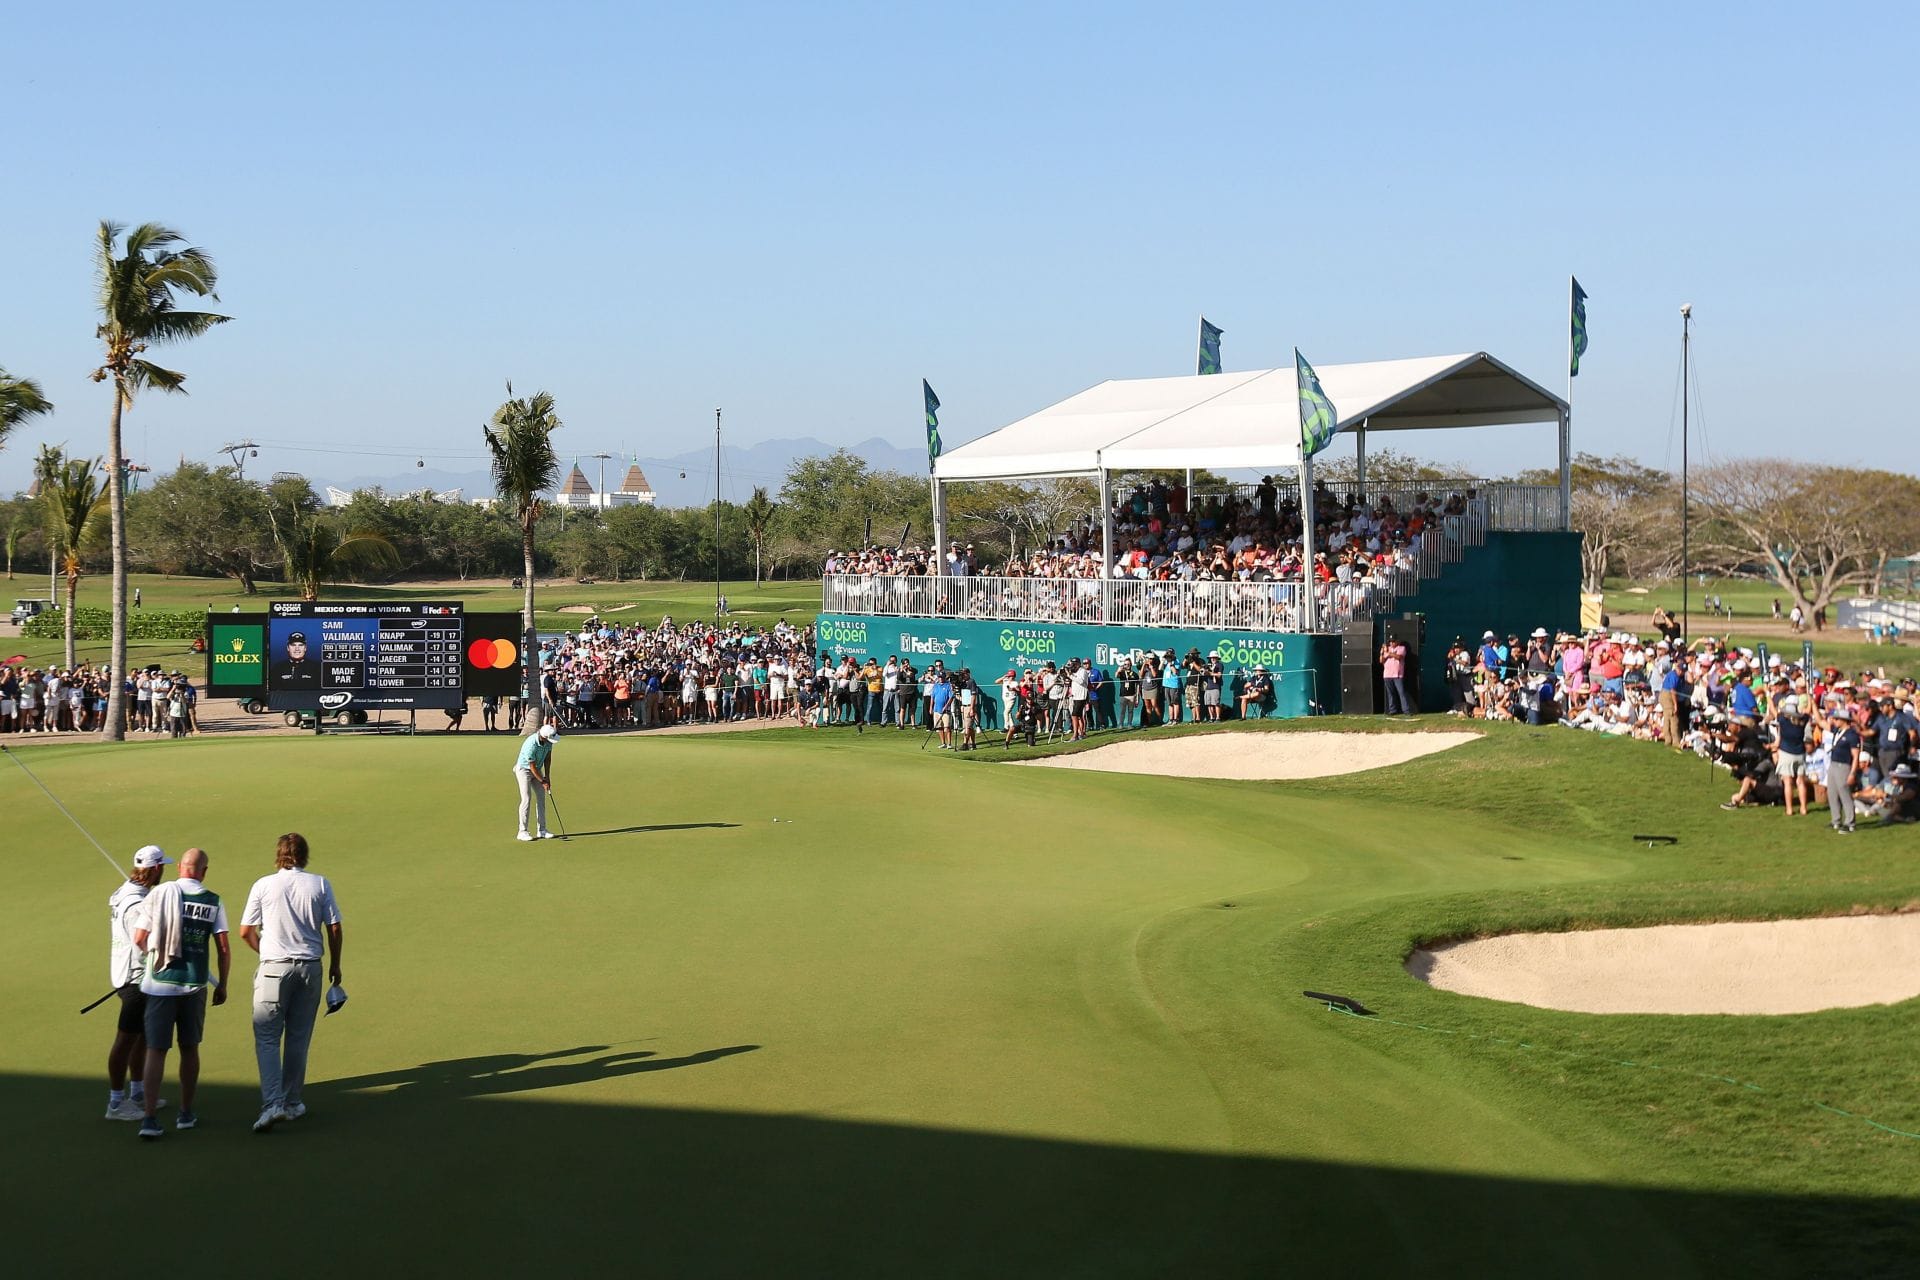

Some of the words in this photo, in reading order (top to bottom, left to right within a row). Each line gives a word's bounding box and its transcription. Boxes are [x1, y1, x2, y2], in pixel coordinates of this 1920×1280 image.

[322, 621, 343, 629] SAMI
[835, 620, 866, 629] MEXICO
[322, 632, 364, 641] VALIMAKI
[371, 632, 375, 640] 1
[379, 632, 405, 640] KNAPP
[834, 627, 867, 643] open
[1017, 629, 1055, 639] MEXICO
[379, 643, 414, 652] VALIMAK
[912, 636, 947, 655] FedEx
[1016, 638, 1056, 655] open
[1238, 639, 1284, 650] MEXICO
[843, 646, 867, 655] VIDANTA
[214, 654, 260, 663] ROLEX
[430, 655, 440, 663] -14
[1237, 648, 1283, 667] open
[331, 667, 355, 675] MADE
[335, 675, 351, 683] PAR
